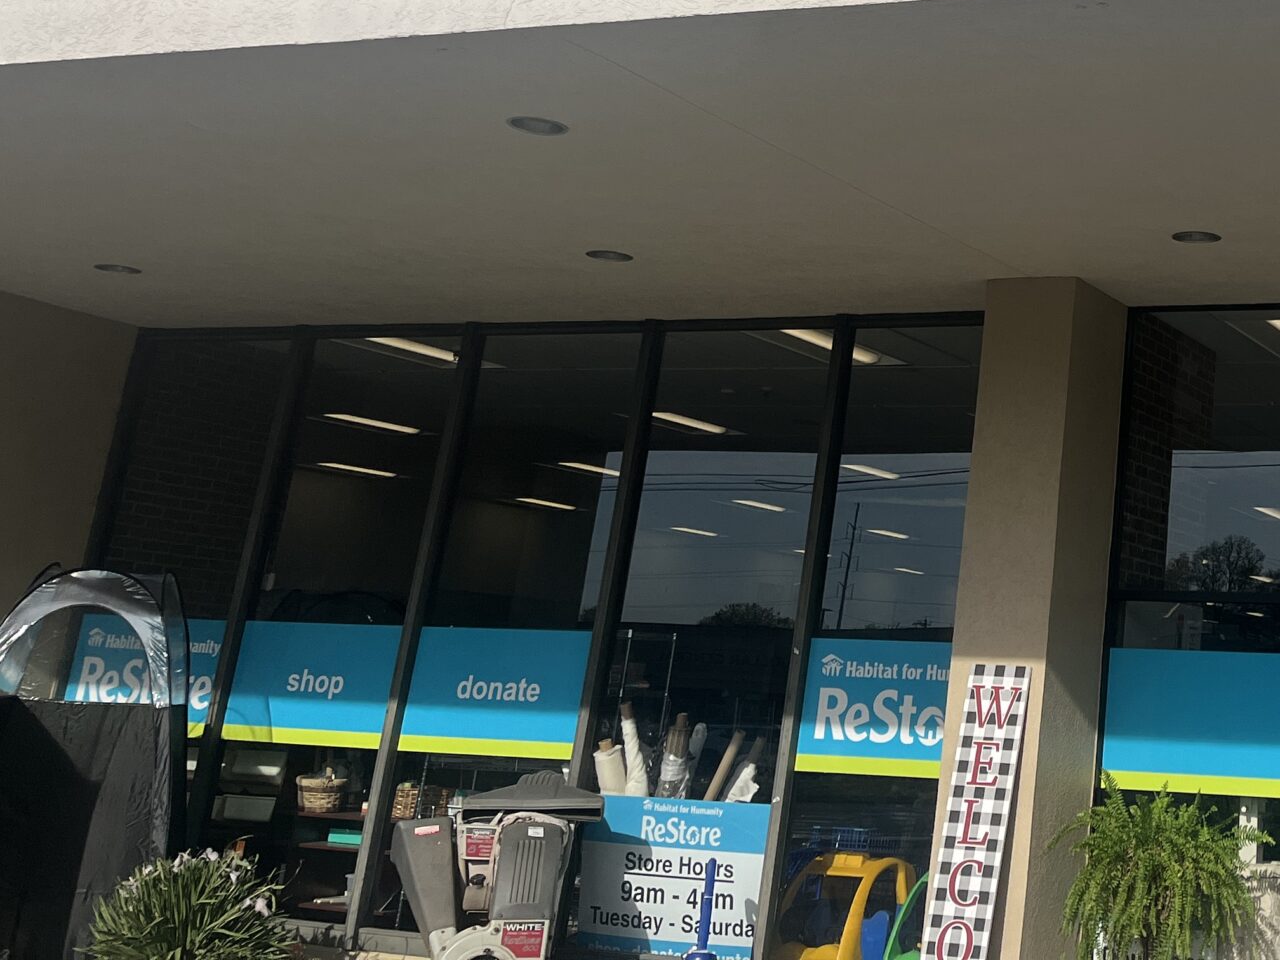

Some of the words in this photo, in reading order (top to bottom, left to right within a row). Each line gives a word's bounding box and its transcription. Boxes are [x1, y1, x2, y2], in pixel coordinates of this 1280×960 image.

[104, 634, 145, 650] Habita
[845, 661, 898, 679] Habitat
[902, 663, 924, 680] for
[286, 669, 345, 700] shop
[456, 675, 541, 702] donate
[654, 802, 678, 814] Habitat
[679, 804, 690, 814] for
[690, 805, 724, 817] Humanity
[641, 815, 722, 847] ReStore
[624, 851, 673, 874] Store
[679, 856, 734, 879] Hors
[620, 880, 665, 905] 9am
[686, 888, 734, 911] 4m
[505, 923, 543, 931] WHITE
[590, 905, 664, 936] Tuesday
[681, 914, 755, 938] Saurda
